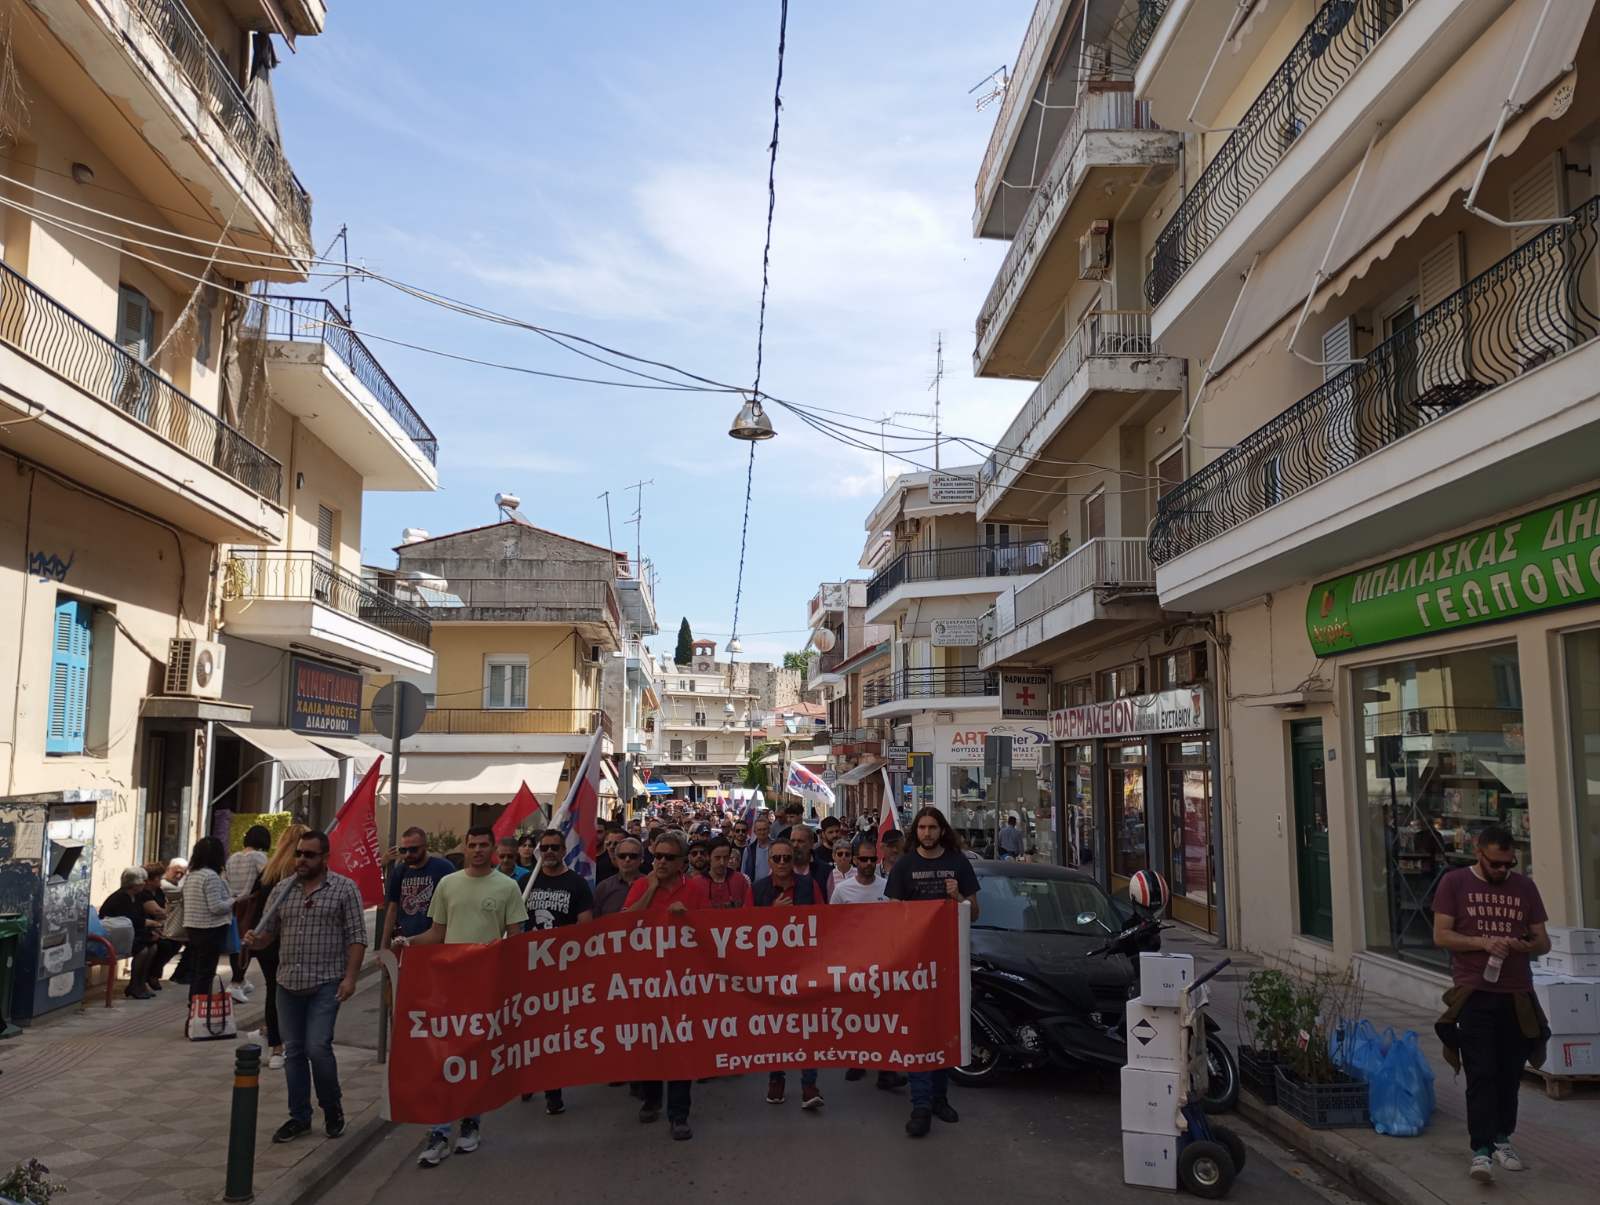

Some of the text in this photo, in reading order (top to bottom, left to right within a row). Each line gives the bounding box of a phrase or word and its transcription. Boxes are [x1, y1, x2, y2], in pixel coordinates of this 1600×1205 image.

[1351, 496, 1600, 604] ΜΠΑΛΑΣΚΑΣ ΔΗ
[305, 715, 349, 731] ΔΙΑΔΡΟΜΟΙ
[1054, 700, 1134, 738] ΦΑΡΜΑΚΕΙΟΝ
[1160, 708, 1192, 730] ΕΥΣΤΑΘΙΟΥ
[527, 900, 570, 914] MURPHYS
[1467, 892, 1521, 907] EMERSON
[1466, 905, 1524, 921] WORKING
[1477, 919, 1512, 933] CLASS
[527, 915, 817, 971] Κρατάμε γερά!
[408, 982, 597, 1040] Συνεχίζουμε
[607, 969, 798, 1001] Αταλάντευτα
[827, 961, 938, 998] Ταξικά!
[443, 1007, 909, 1083] Οι Σημαίες ψηλά να ανεμίζουν.
[716, 1047, 945, 1070] Εργατικό κέντρο Αρτας
